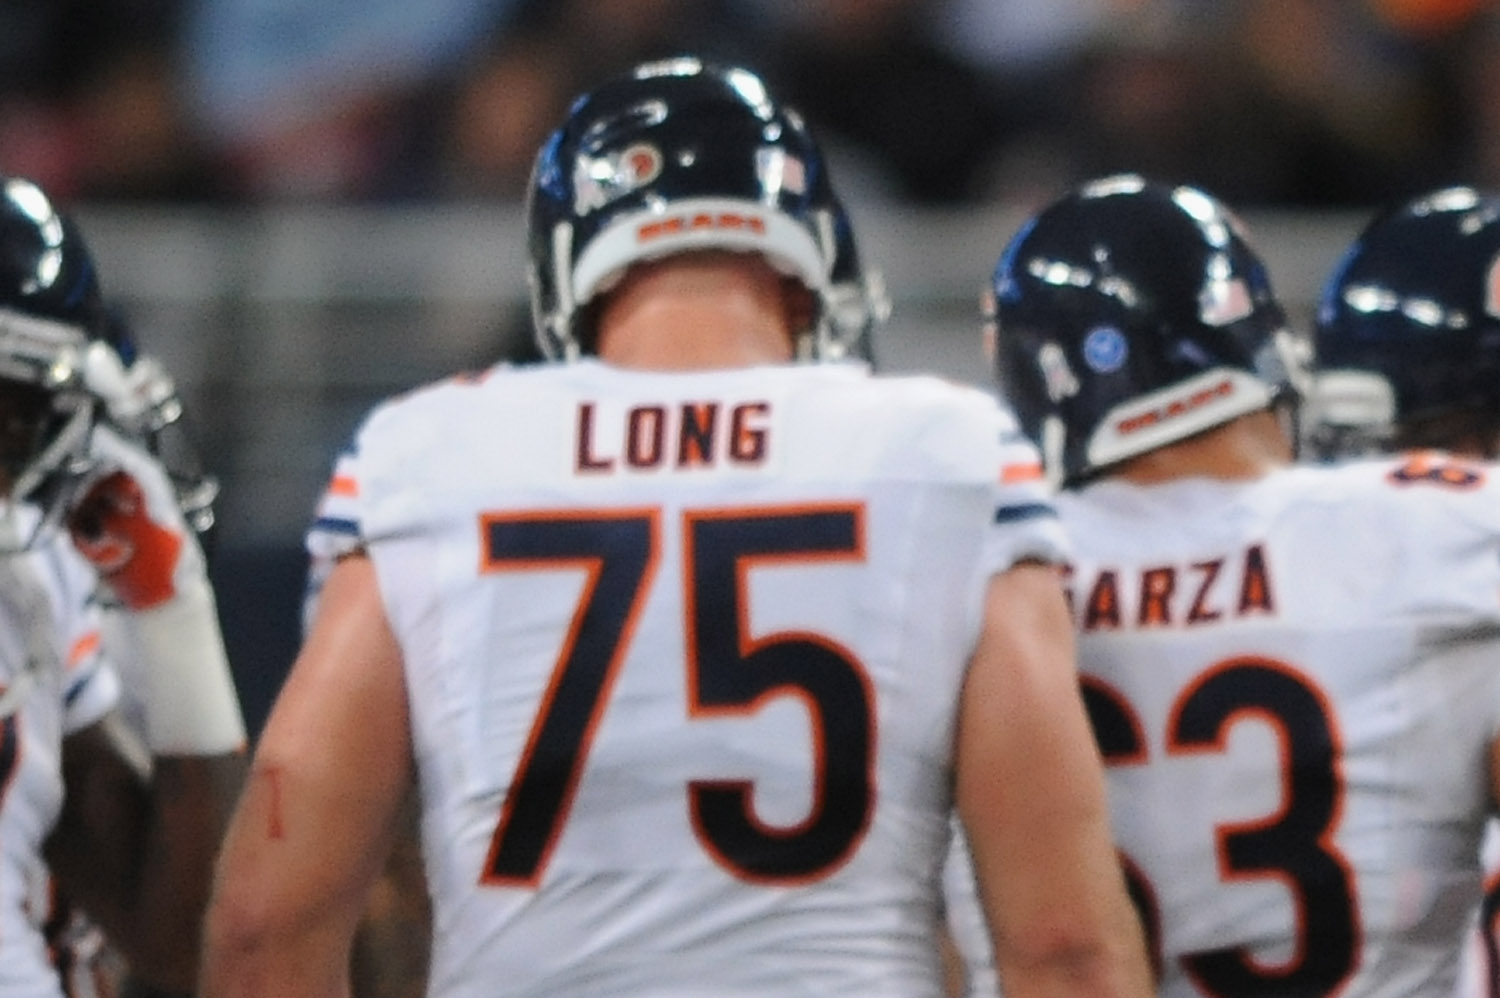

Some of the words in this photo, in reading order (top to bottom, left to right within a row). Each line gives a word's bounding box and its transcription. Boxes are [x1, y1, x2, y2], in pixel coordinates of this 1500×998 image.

[575, 401, 771, 476] LONG
[1061, 540, 1278, 635] ARZA
[477, 501, 877, 888] 75
